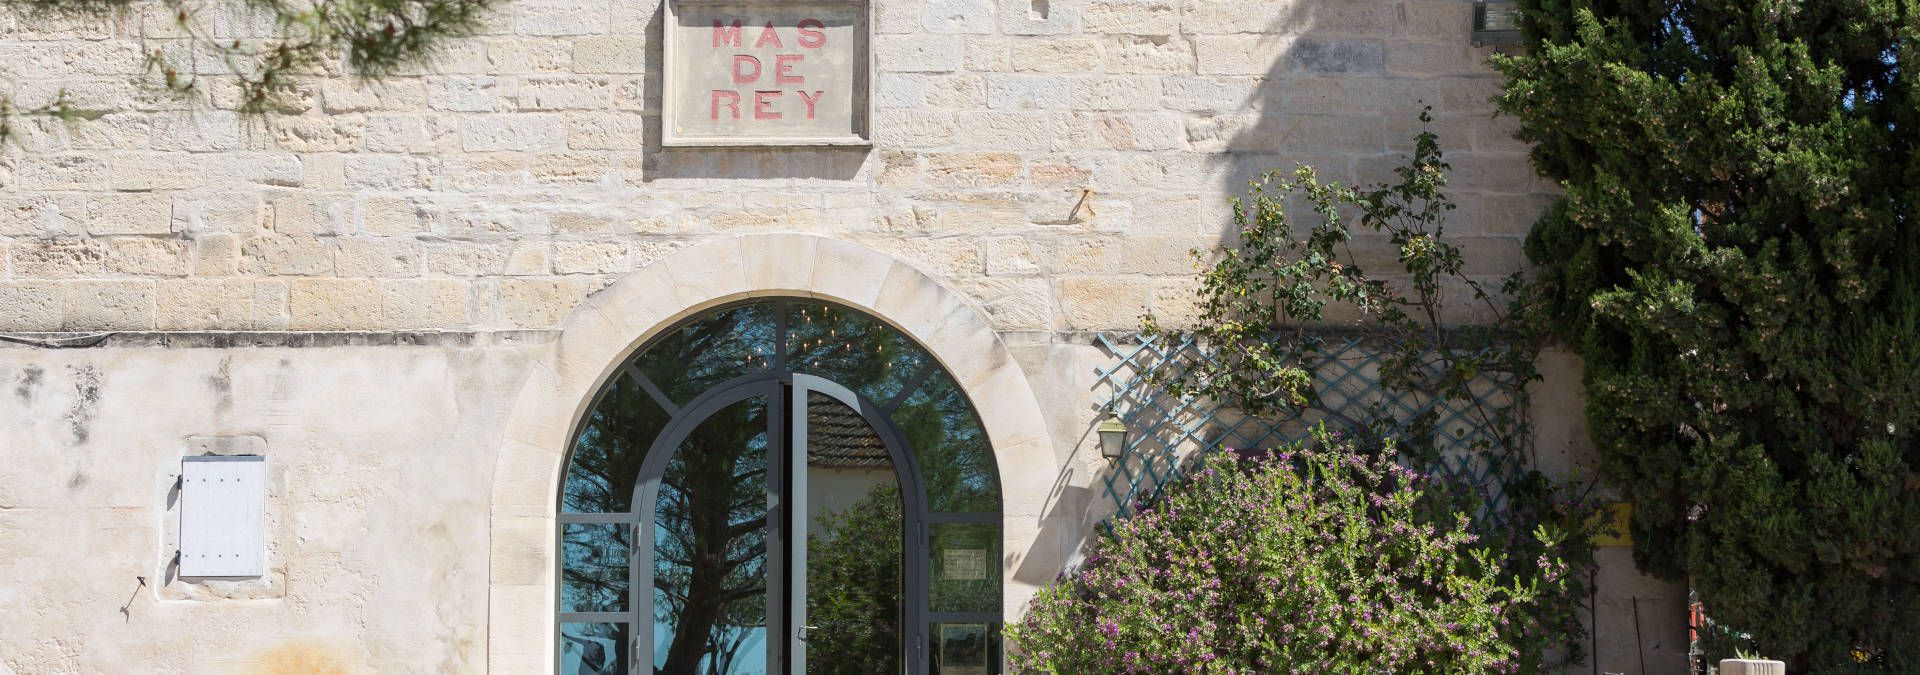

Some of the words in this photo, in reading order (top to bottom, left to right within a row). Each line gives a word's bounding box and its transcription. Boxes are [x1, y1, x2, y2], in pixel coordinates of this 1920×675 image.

[712, 19, 827, 49] MAS
[732, 54, 804, 84] DE
[711, 89, 824, 120] REY
